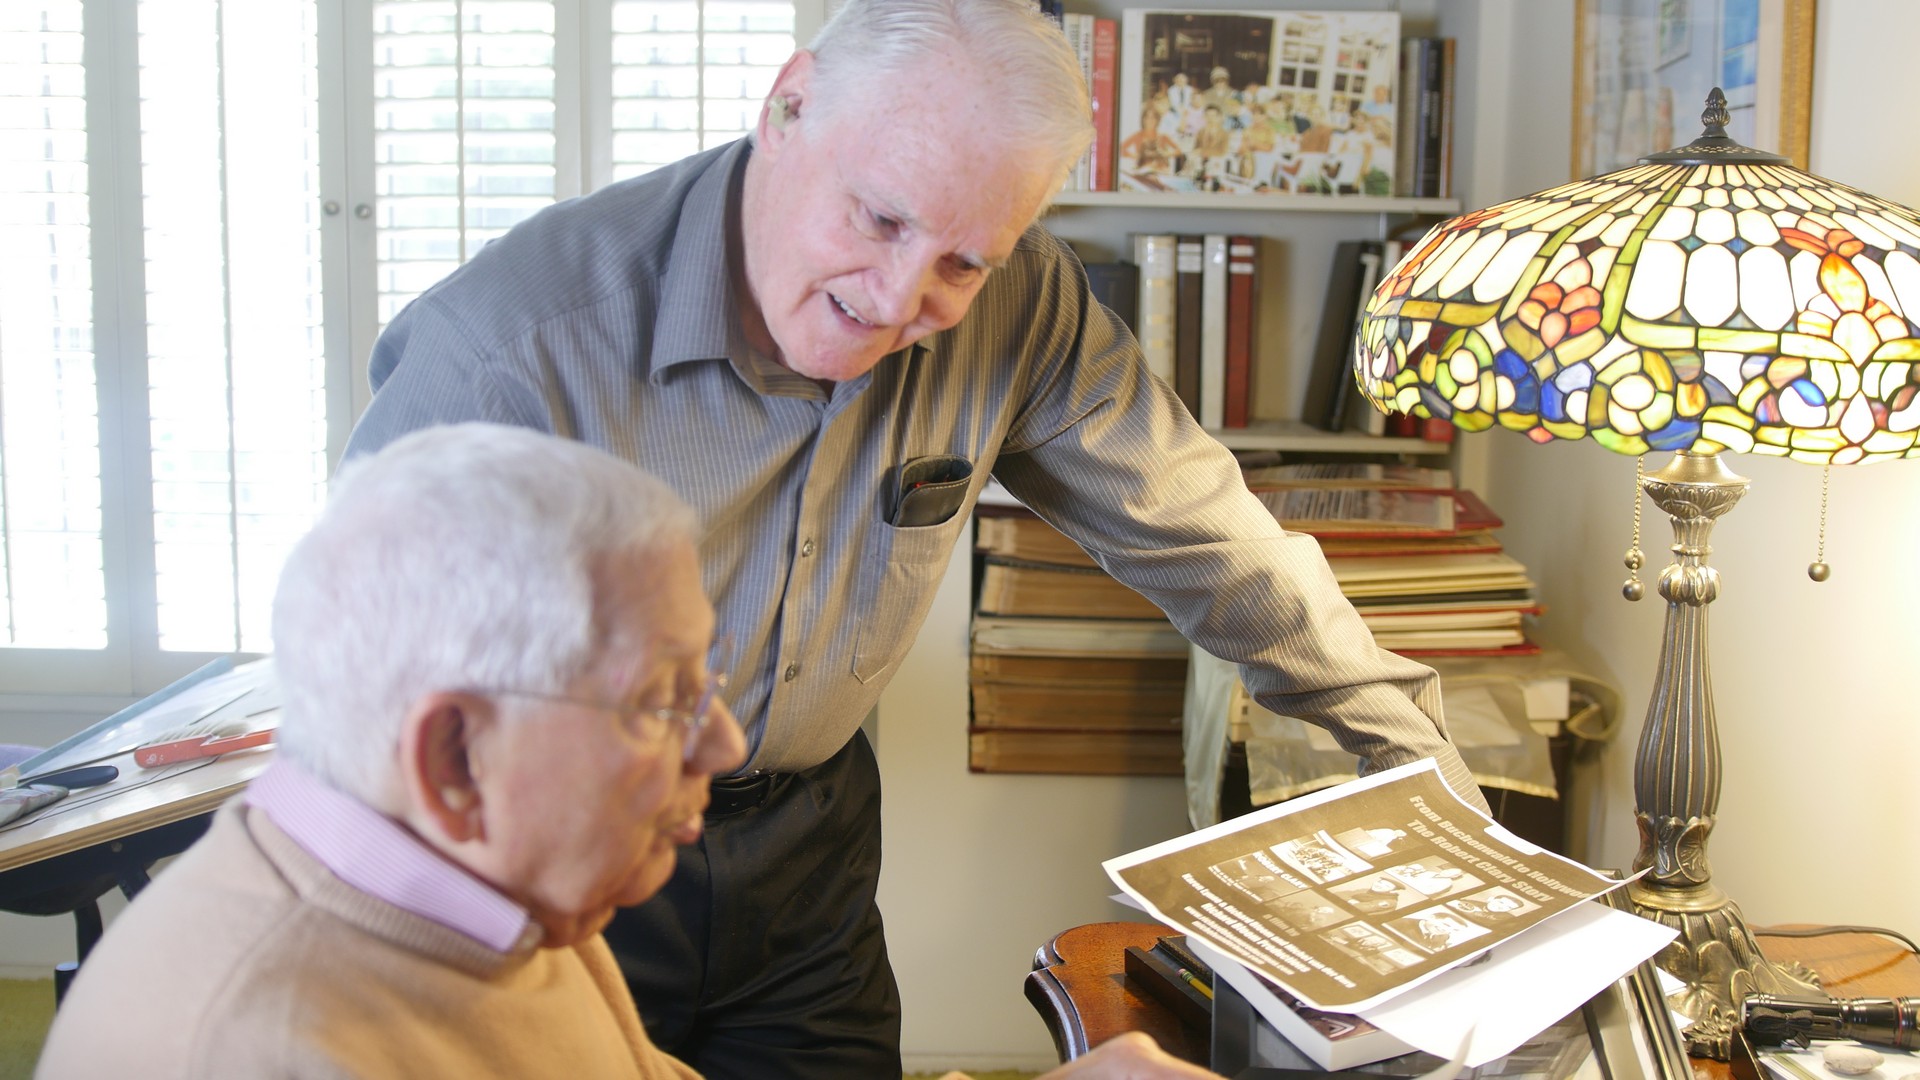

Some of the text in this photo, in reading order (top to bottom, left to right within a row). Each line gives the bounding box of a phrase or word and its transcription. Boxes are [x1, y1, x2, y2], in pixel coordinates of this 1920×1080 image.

[1407, 819, 1555, 902] The Robert Clary Story
[1409, 795, 1591, 898] From Buchenwald to Hollywoo
[1201, 902, 1238, 926] Richard
[1256, 939, 1311, 973] Productions
[1269, 917, 1289, 930] film
